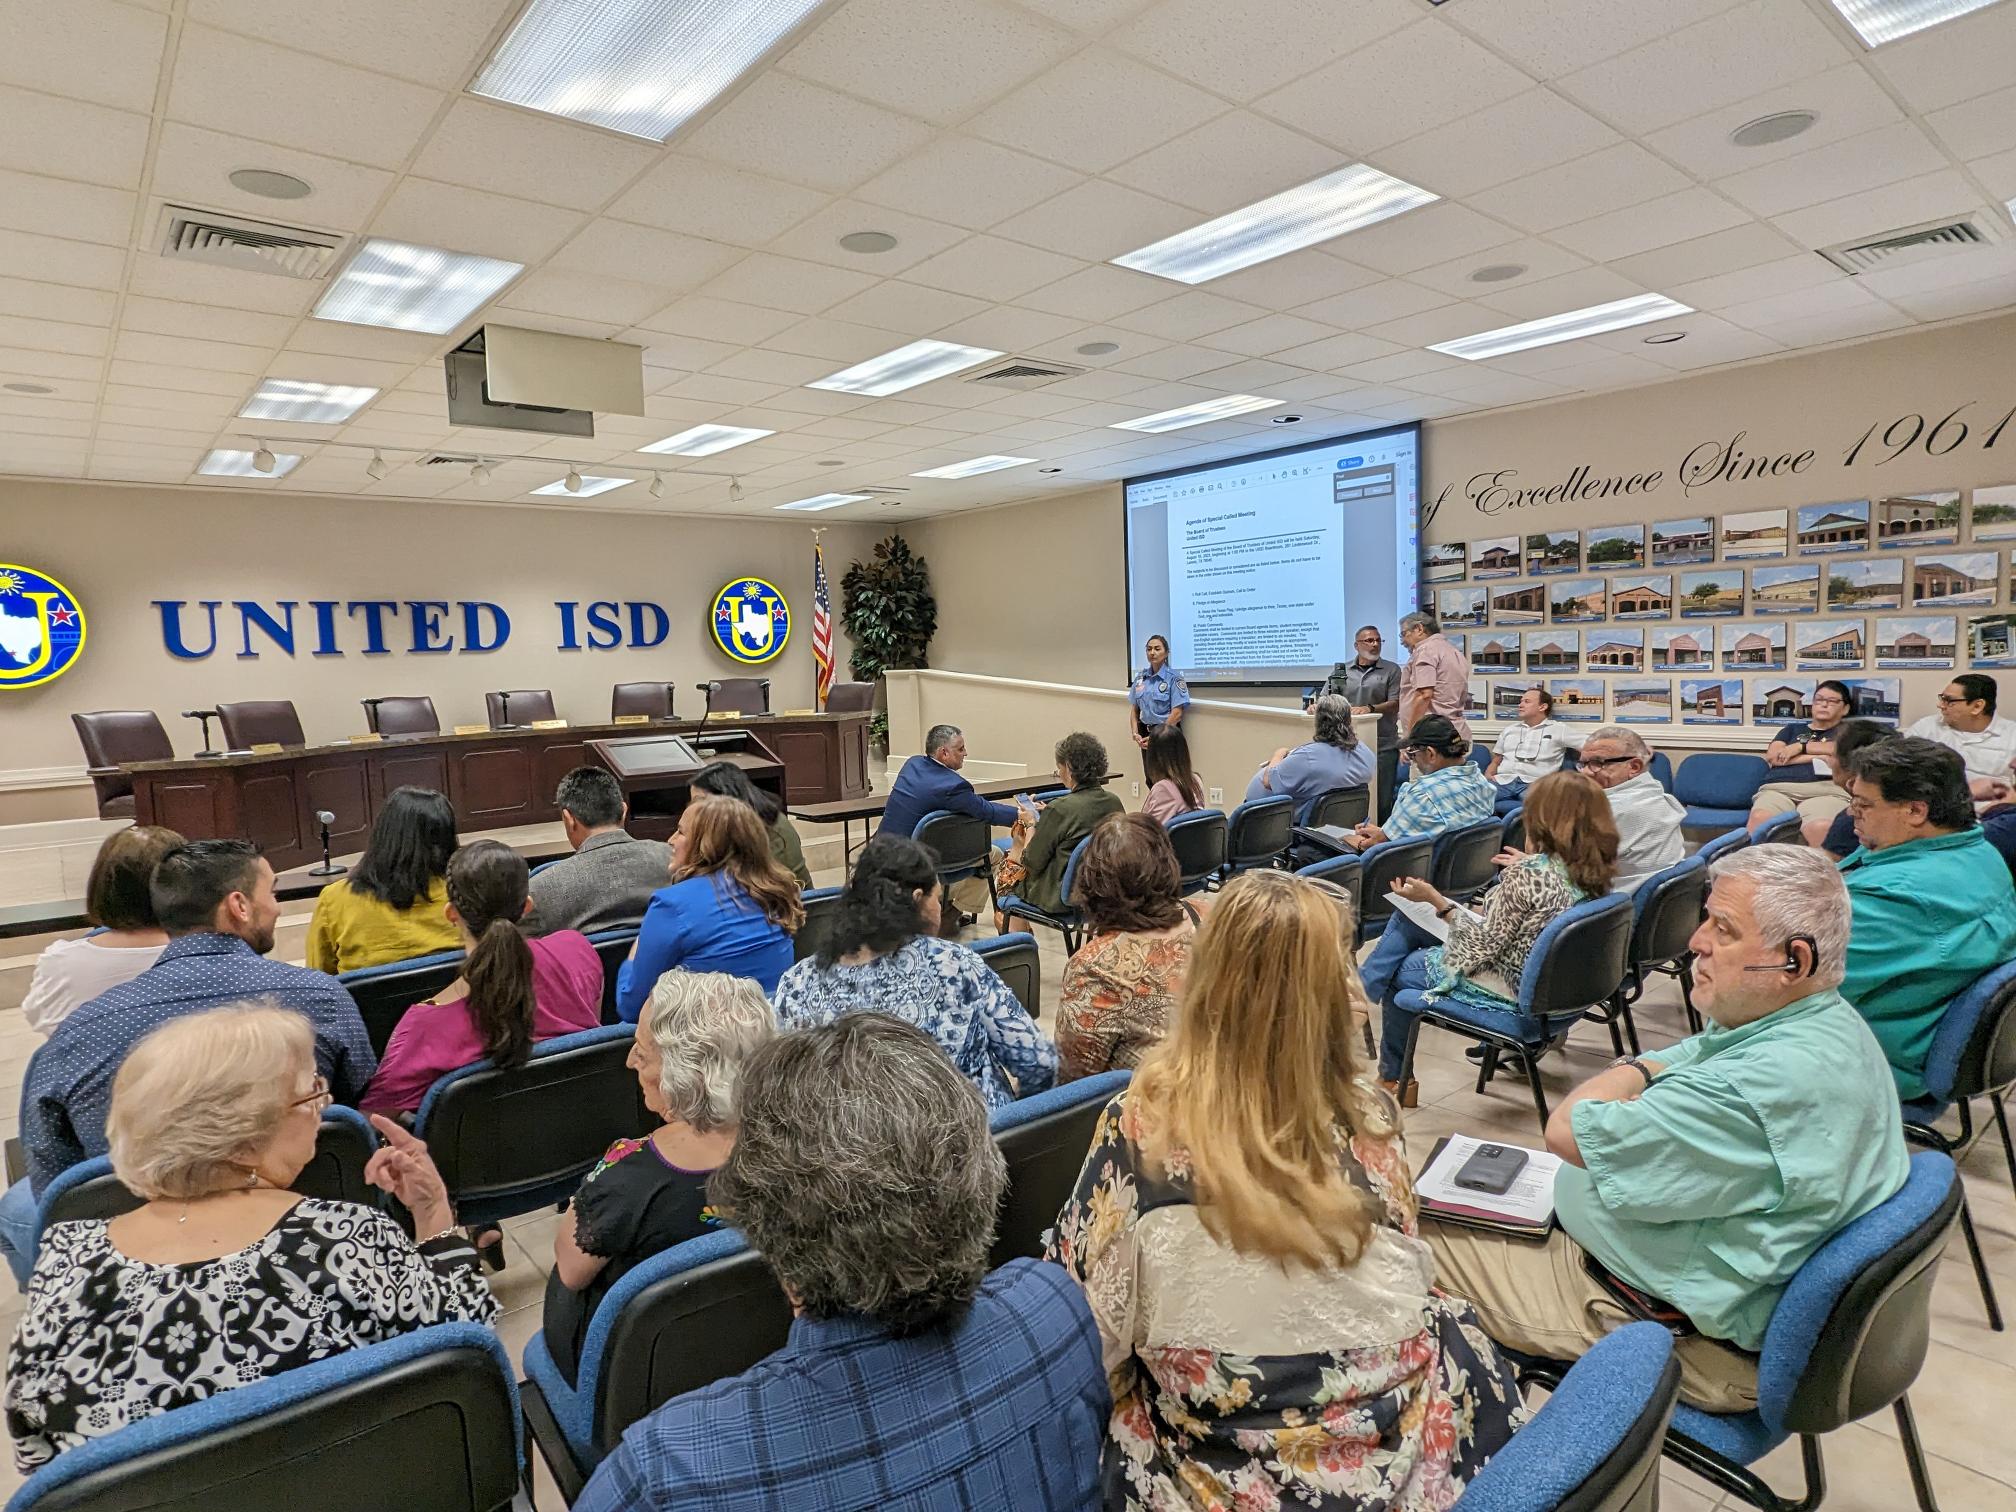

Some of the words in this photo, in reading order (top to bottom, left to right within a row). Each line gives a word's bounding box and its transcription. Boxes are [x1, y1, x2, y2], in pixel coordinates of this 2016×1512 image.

[1465, 465, 1664, 516] Excellence
[1679, 430, 1815, 497] Since
[1842, 400, 2016, 467] 1961
[151, 601, 511, 658] UNITED
[554, 602, 670, 651] ISD
